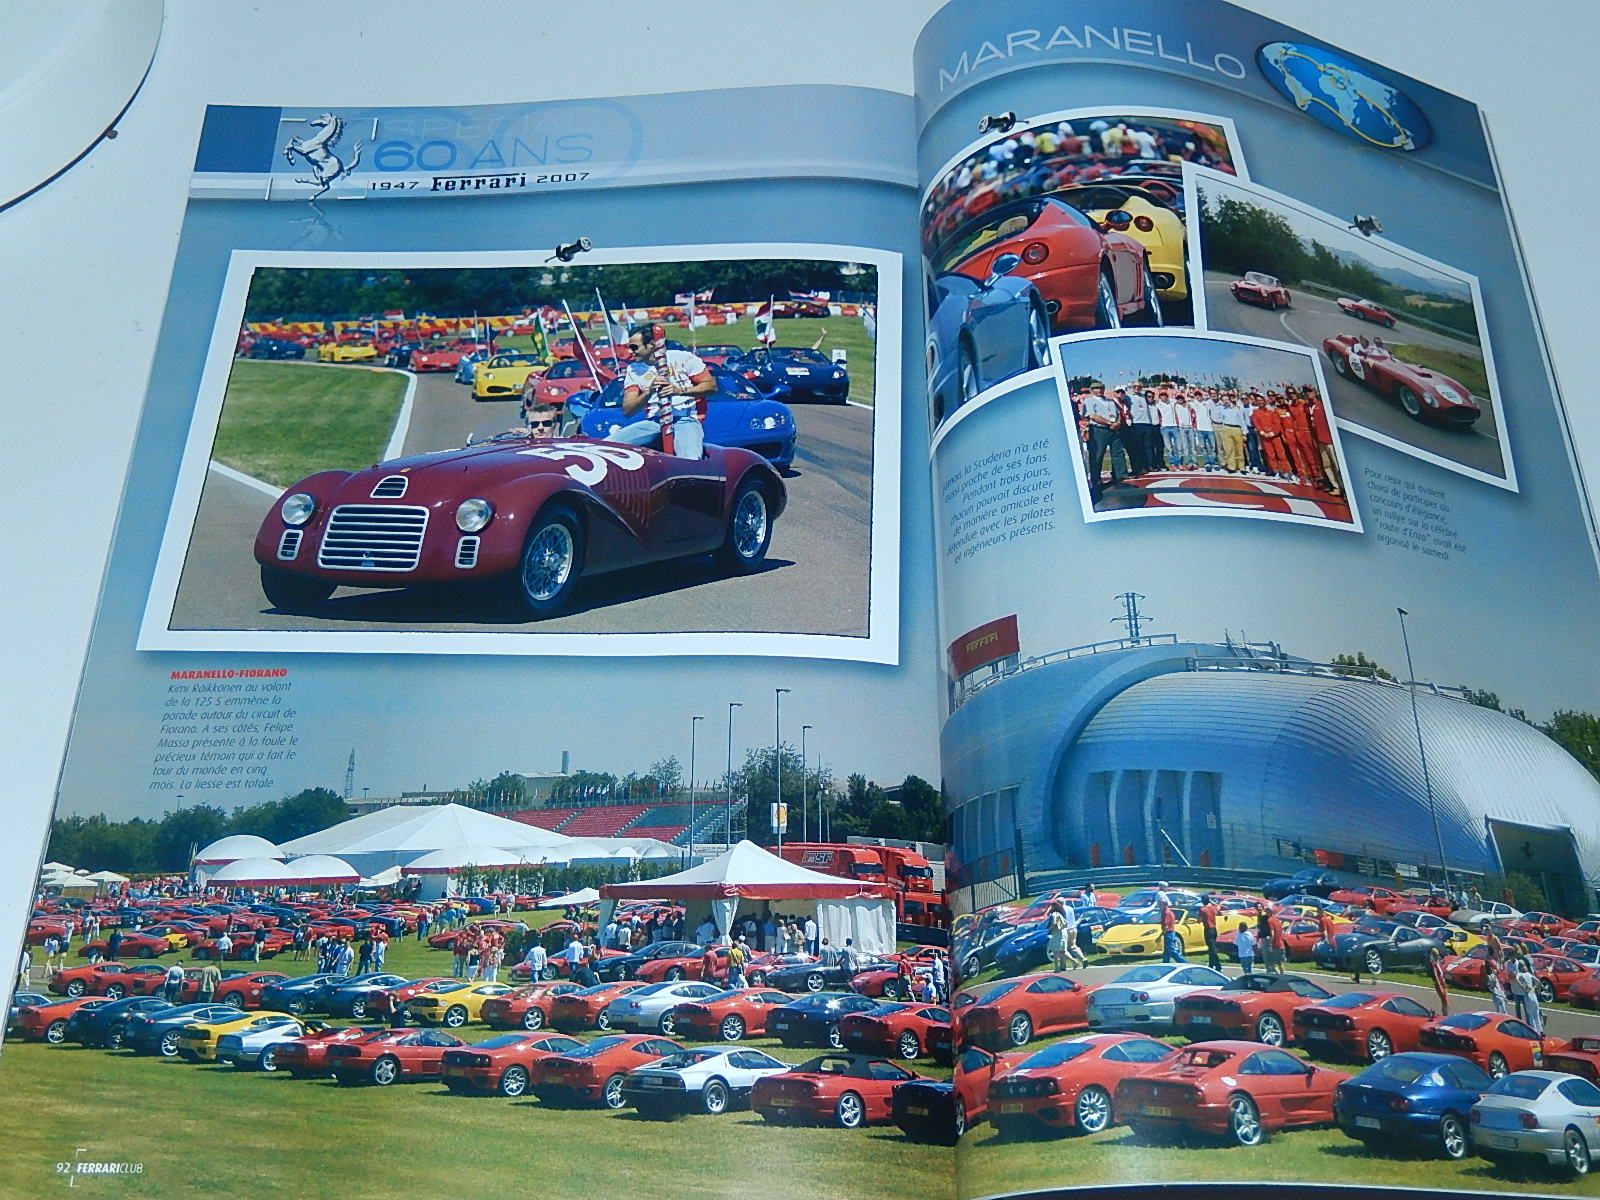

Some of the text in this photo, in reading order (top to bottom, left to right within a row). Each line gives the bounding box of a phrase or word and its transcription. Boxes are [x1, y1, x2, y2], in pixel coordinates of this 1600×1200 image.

[938, 25, 1247, 92] MARANELLO
[372, 134, 595, 173] 60 ANS
[371, 171, 591, 193] 1947 Ferrari 2007
[974, 449, 1011, 470] Scuderia
[1014, 443, 1028, 455] n'a
[1032, 438, 1049, 450] été
[961, 471, 988, 492] proche
[992, 465, 1003, 476] de
[1006, 460, 1022, 470] ses
[1025, 454, 1049, 465] fans.
[1364, 467, 1381, 480] Pour
[1403, 480, 1415, 490] qui
[962, 467, 1050, 503] Pendant trois jours,
[976, 490, 1010, 512] pouvait
[1012, 480, 1053, 496] discuter
[1391, 488, 1401, 498] de
[1440, 503, 1450, 513] au
[964, 508, 998, 529] manière
[1000, 494, 1040, 514] amicale
[1043, 493, 1054, 503] et
[980, 521, 1000, 536] avec
[1004, 515, 1018, 527] les
[1020, 507, 1055, 524] pilotes
[1422, 520, 1429, 530] la
[964, 531, 1006, 559] ingénieurs
[1009, 521, 1056, 542] présents.
[1412, 541, 1419, 552] le
[170, 668, 288, 679] MARANELLO-FIORANO
[168, 683, 188, 694] Kimi
[245, 684, 257, 692] au
[261, 682, 292, 692] volant
[165, 695, 282, 707] de la 125 S emmène la
[162, 708, 296, 722] parade autour du circuit de
[160, 722, 294, 734] Fiorano. A ses côtés, Felipe
[157, 735, 299, 749] Massa présente à la foule le
[154, 749, 296, 763] précieux témoin qui a fait le
[153, 764, 268, 776] tour du monde en cinq
[179, 780, 192, 789] La
[194, 779, 223, 789] liesse
[225, 779, 242, 788] est
[56, 1162, 71, 1173] 92
